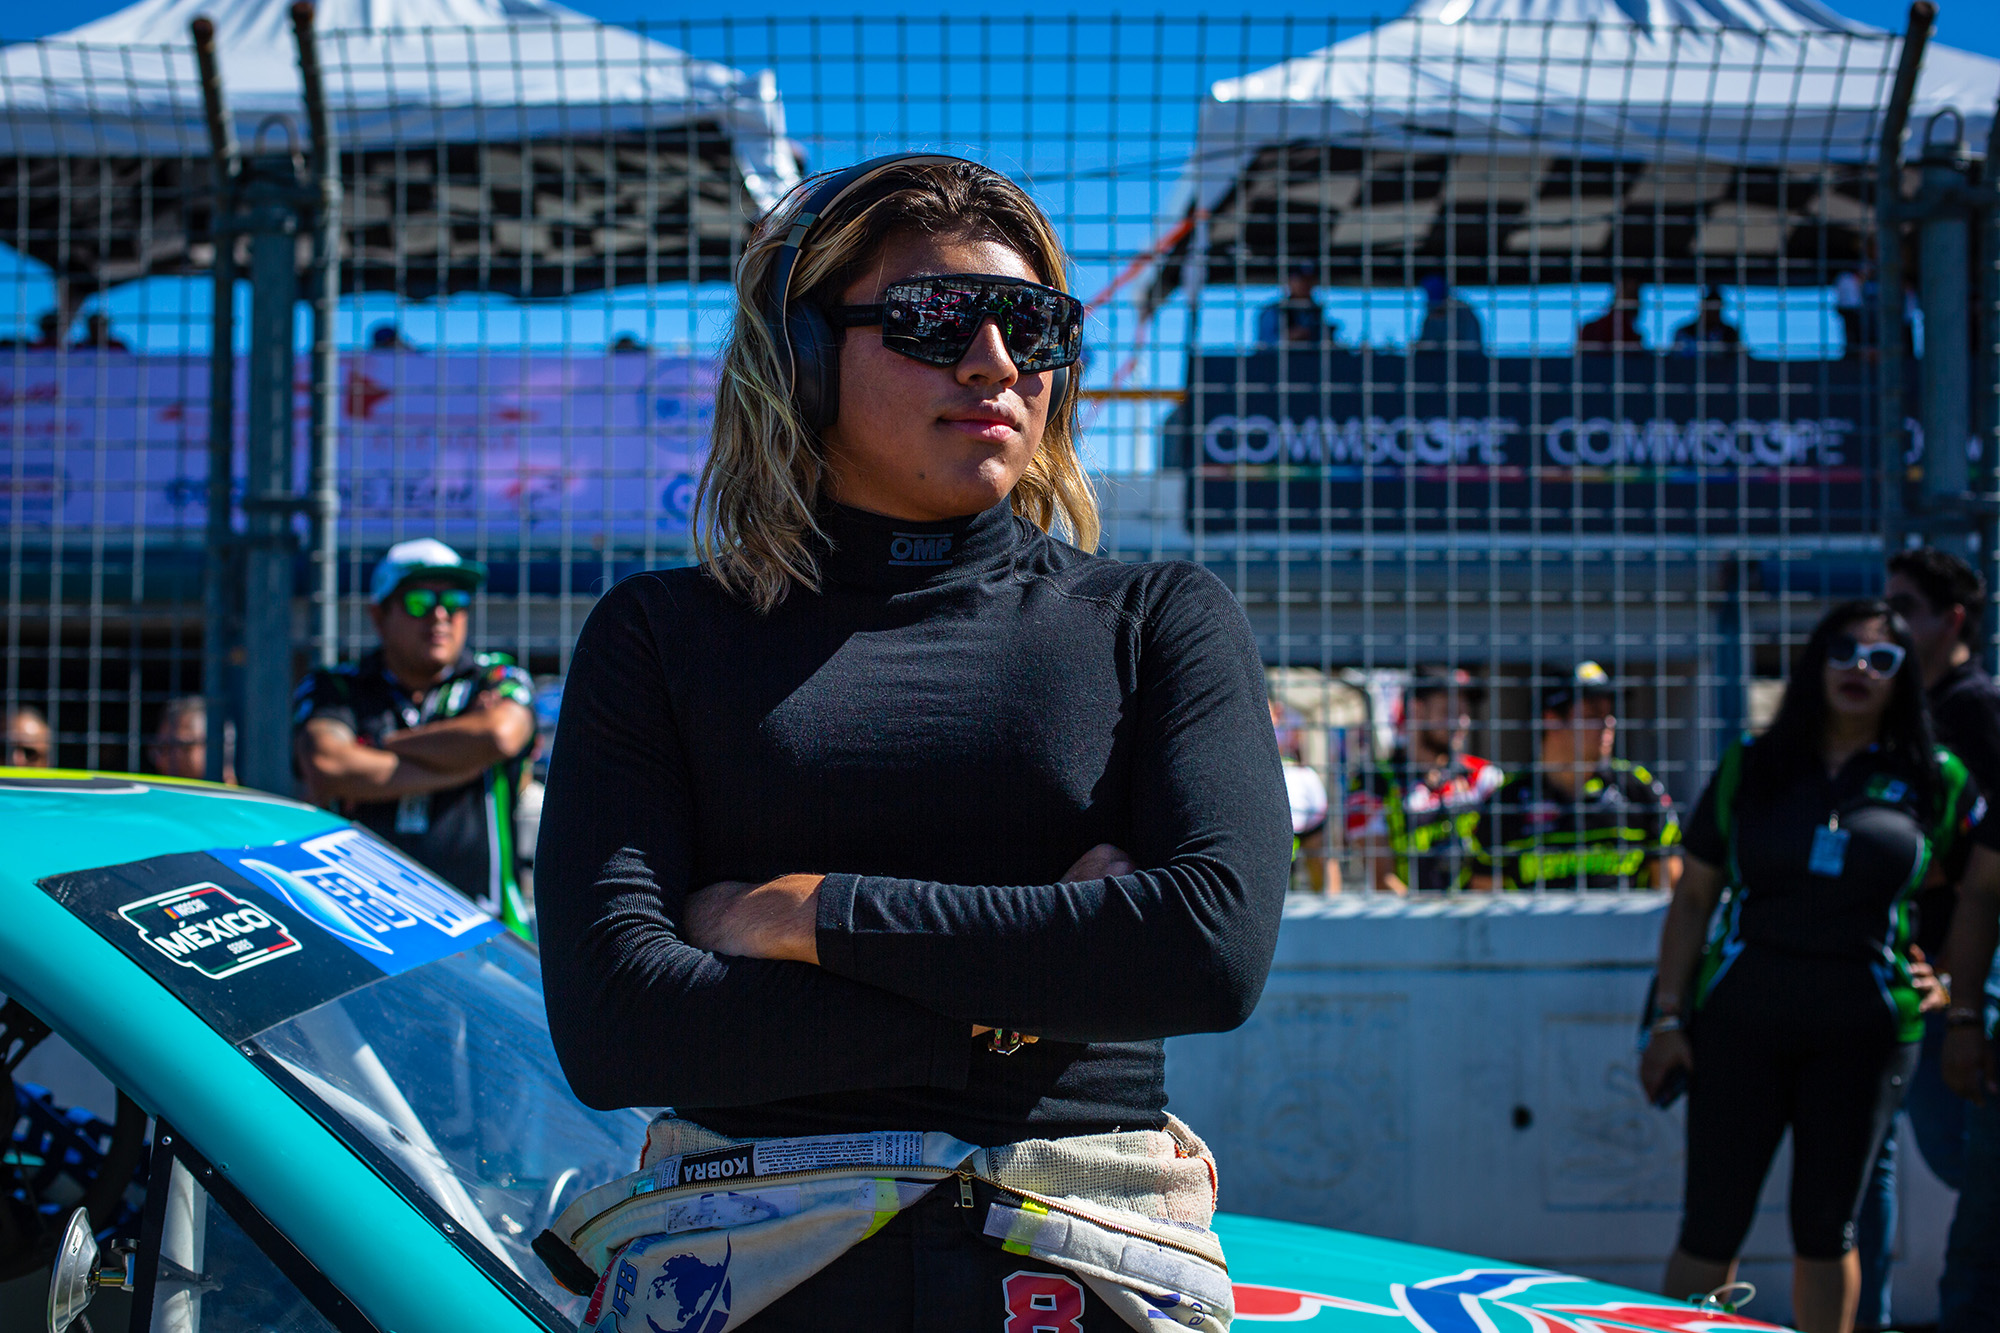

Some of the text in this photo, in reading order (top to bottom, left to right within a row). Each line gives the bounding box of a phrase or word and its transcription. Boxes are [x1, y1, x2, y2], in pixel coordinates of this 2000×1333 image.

[1205, 414, 1512, 464] COMMSCOPE
[1546, 417, 1848, 466] COMMSCOPE
[890, 537, 952, 560] OMP
[154, 908, 272, 958] MÉXICO
[684, 1157, 749, 1182] KOBRA
[612, 1258, 639, 1318] FB
[1002, 1270, 1085, 1333] 8
